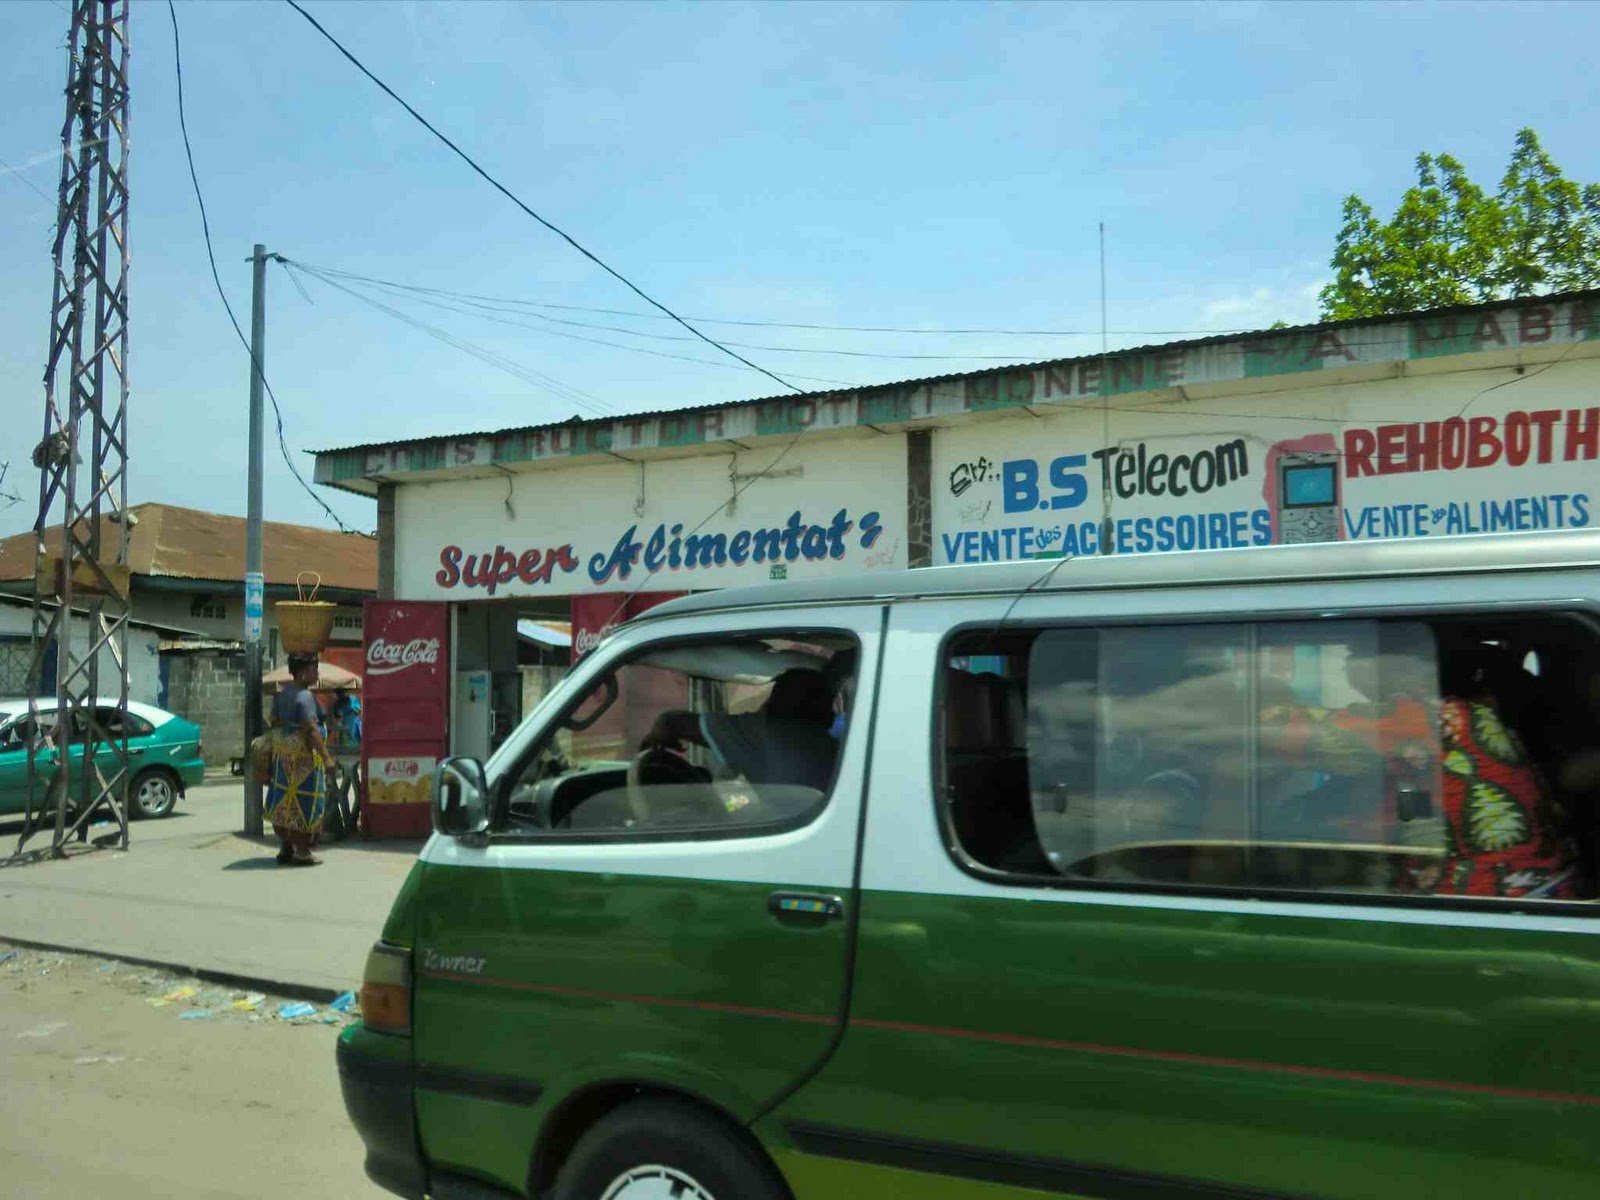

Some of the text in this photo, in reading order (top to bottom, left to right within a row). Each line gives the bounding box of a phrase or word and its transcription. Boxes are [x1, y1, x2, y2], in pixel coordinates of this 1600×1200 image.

[1344, 407, 1600, 478] REHOBOTH
[1003, 454, 1088, 514] B.S
[1092, 439, 1249, 499] Telecom
[1344, 503, 1429, 539] VENTE
[1446, 494, 1590, 535] ALIMENTS
[435, 544, 580, 596] Super
[942, 527, 1035, 564] VENTE
[1035, 526, 1062, 549] des
